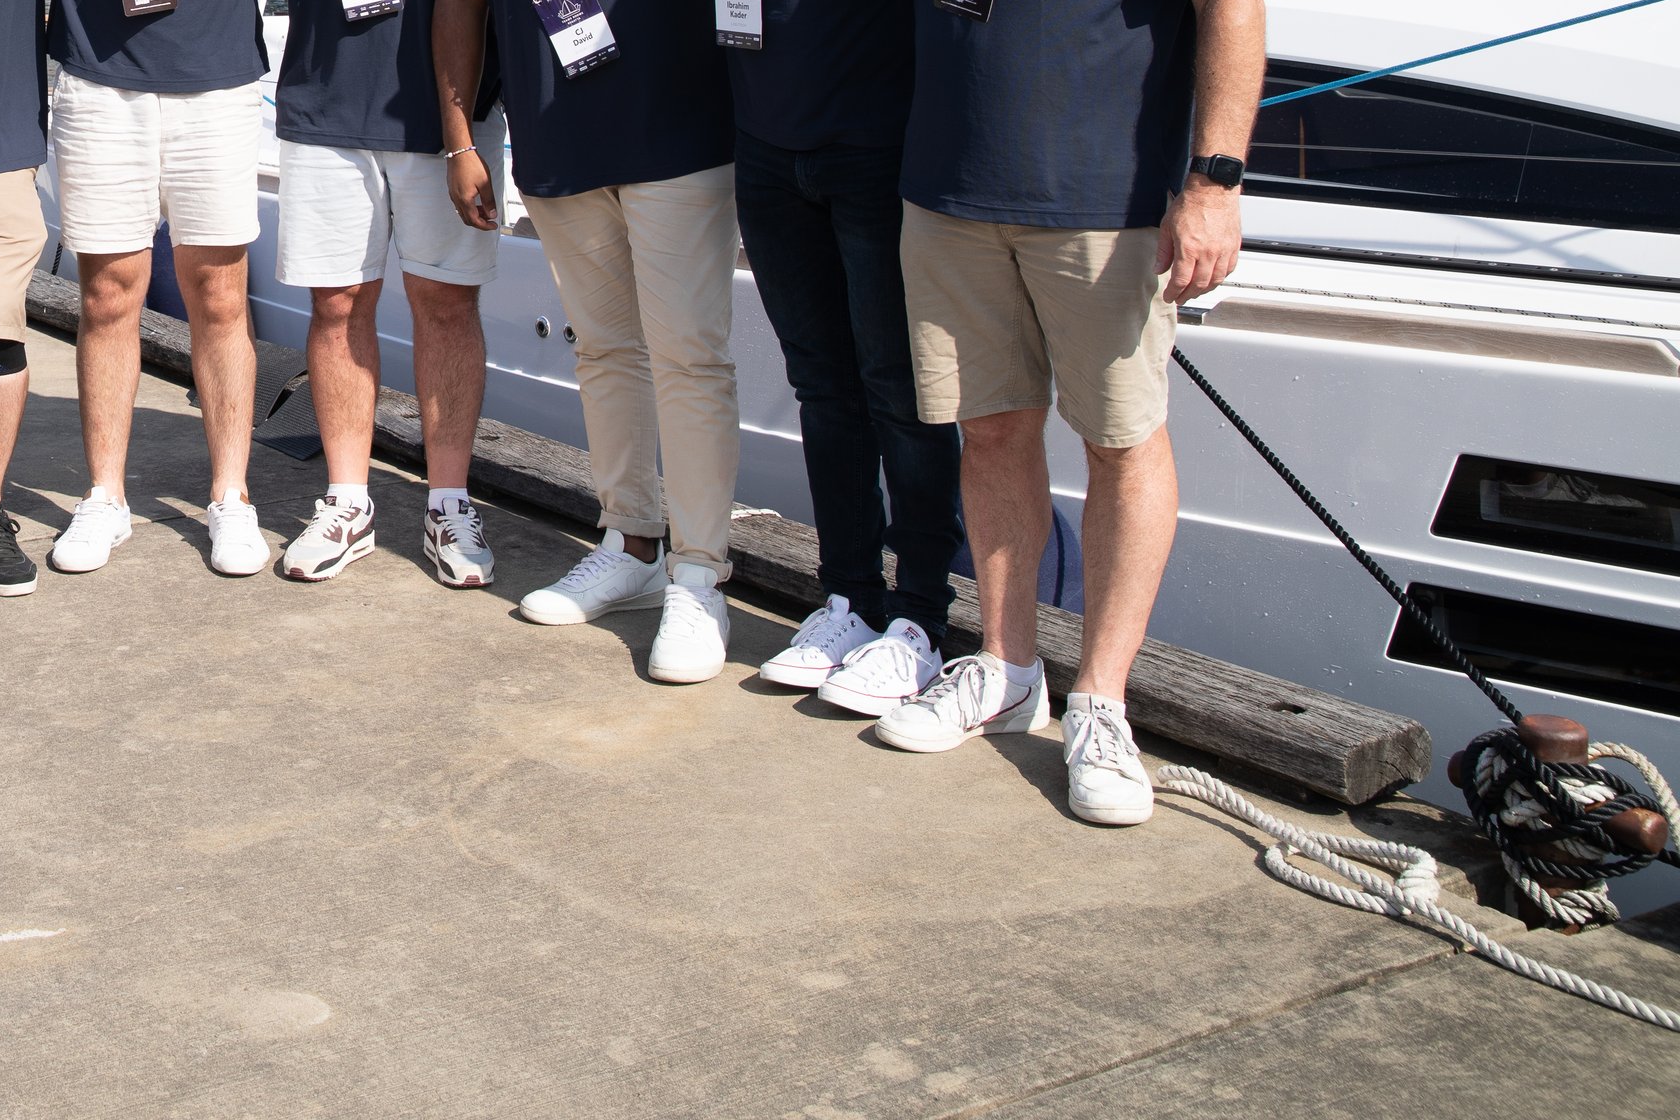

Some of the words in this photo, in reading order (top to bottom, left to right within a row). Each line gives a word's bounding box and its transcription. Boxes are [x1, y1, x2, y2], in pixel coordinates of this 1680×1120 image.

[726, 0, 750, 11] Ibrahim
[729, 10, 747, 19] Kader
[574, 27, 584, 36] CJ
[573, 32, 594, 47] David
